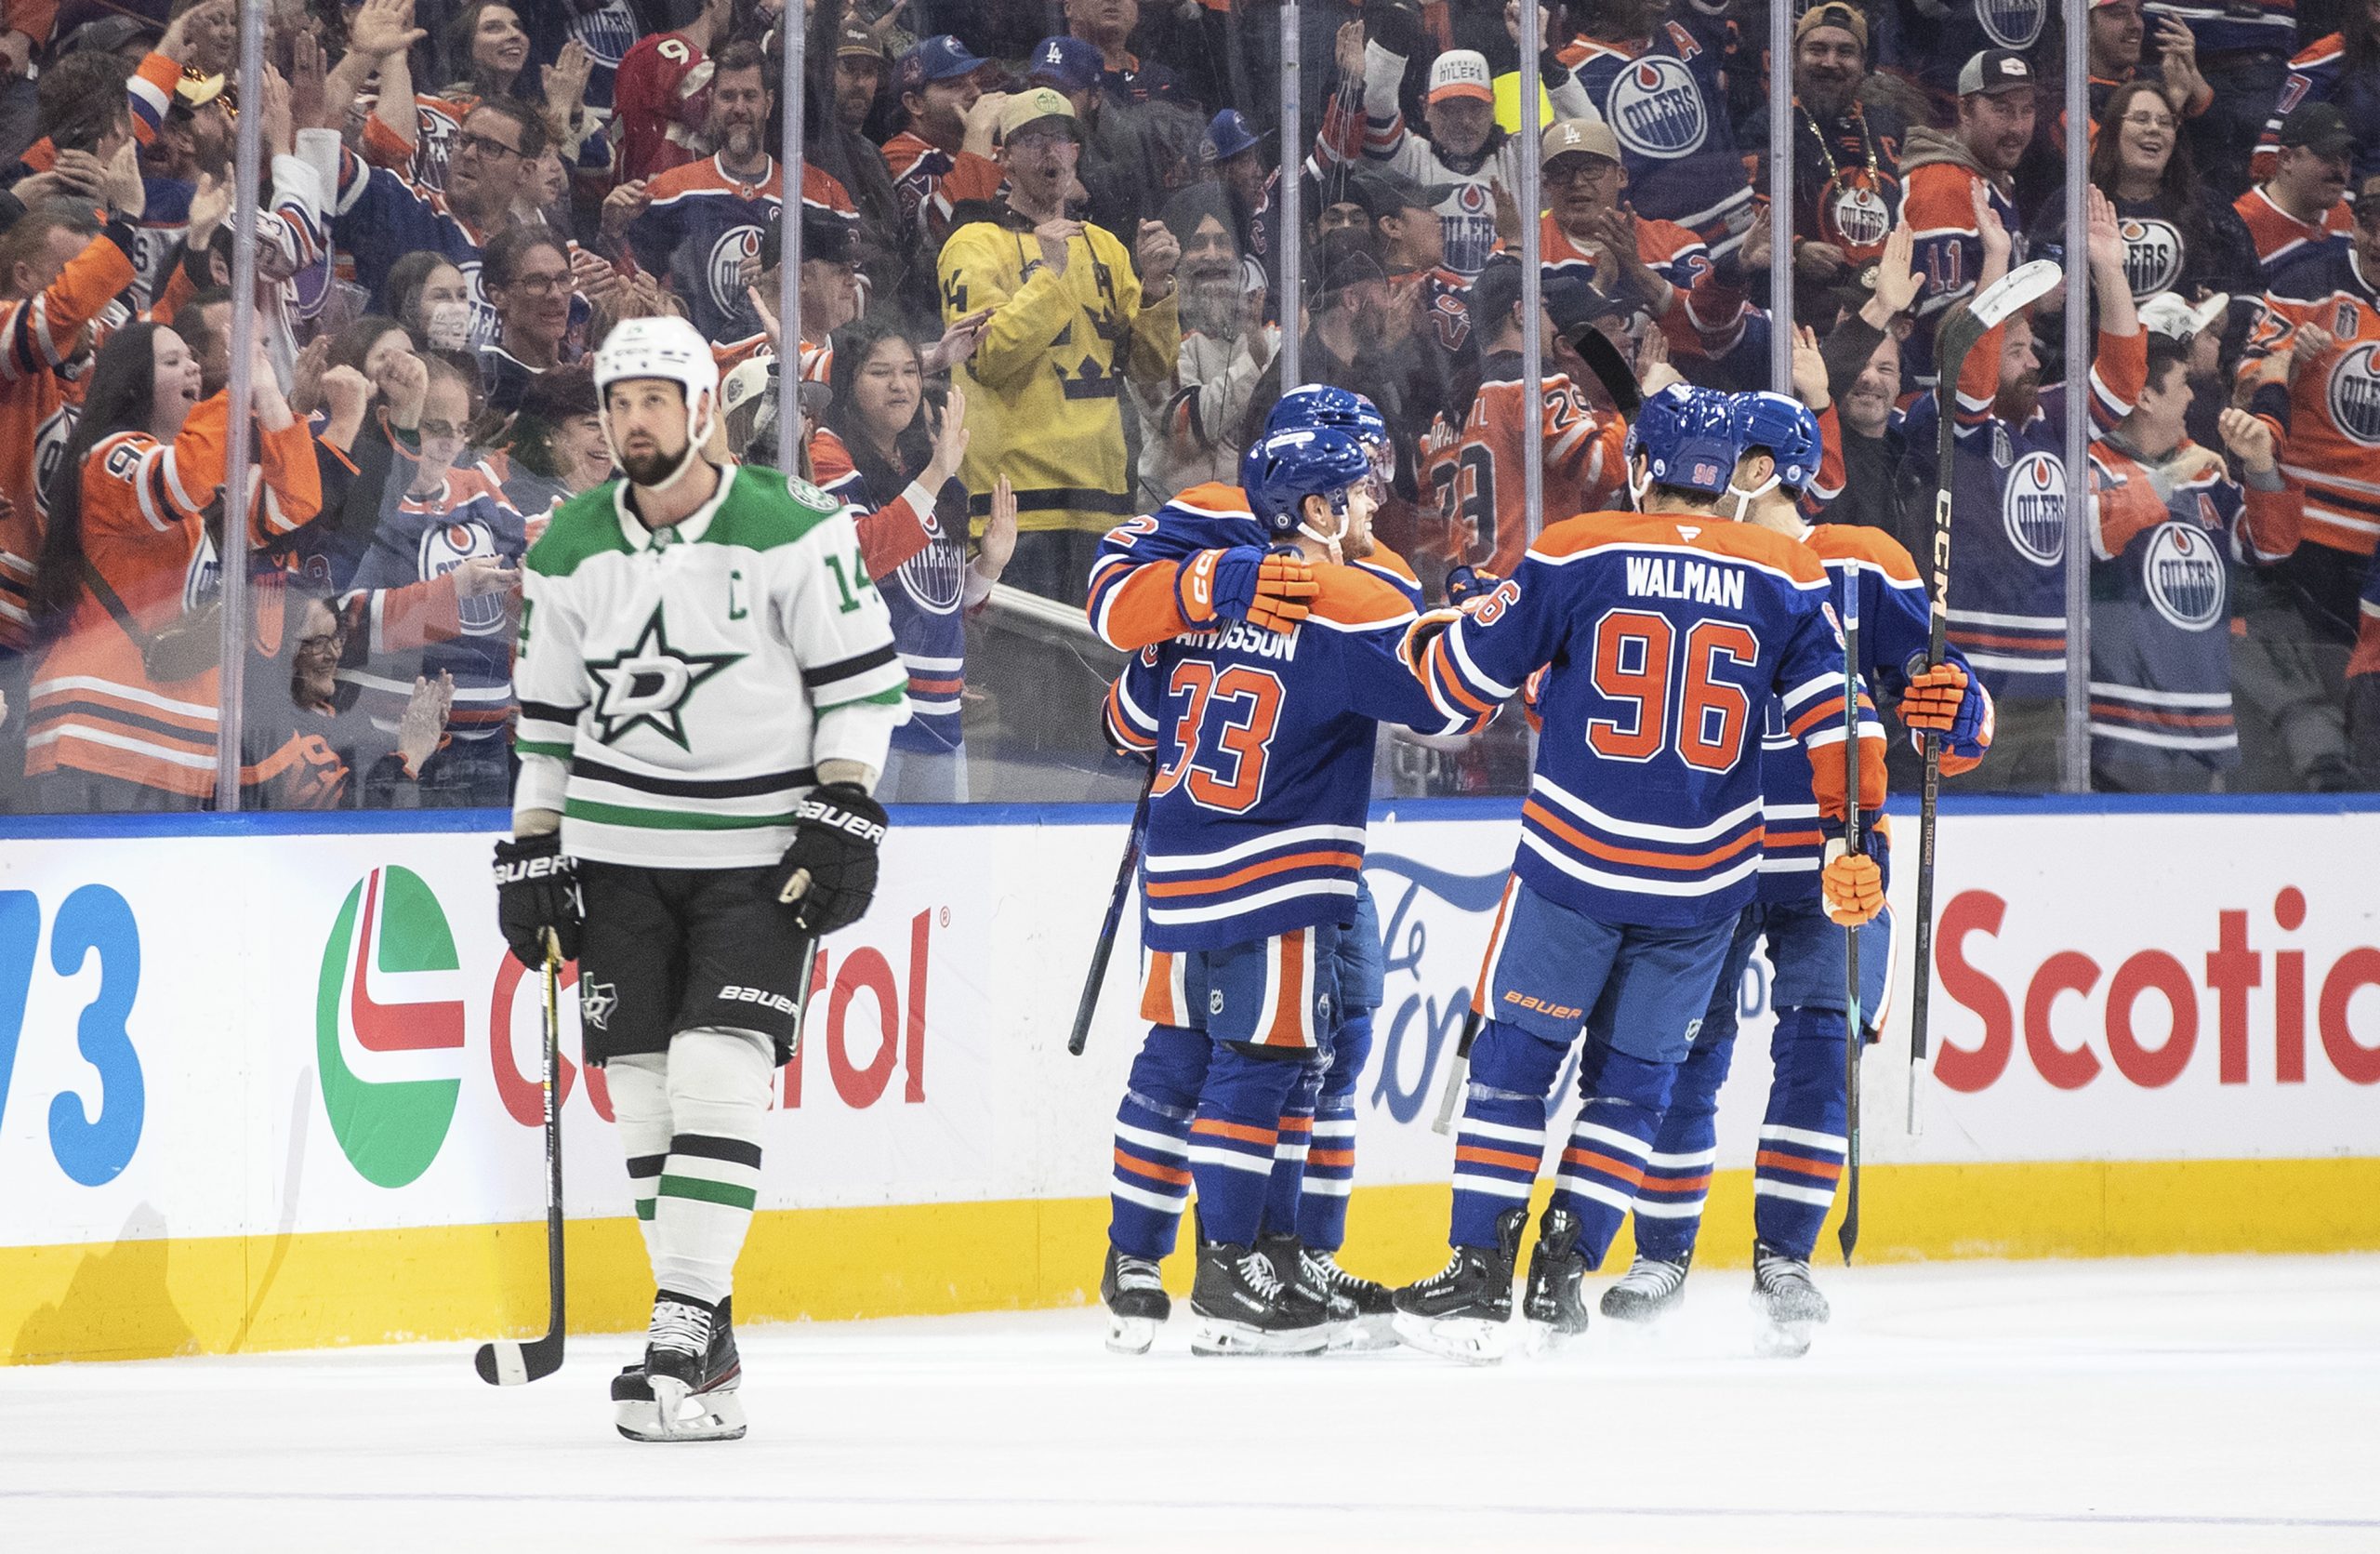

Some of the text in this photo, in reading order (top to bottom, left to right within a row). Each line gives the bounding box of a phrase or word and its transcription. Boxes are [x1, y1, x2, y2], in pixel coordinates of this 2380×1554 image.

[657, 39, 690, 65] 9
[1047, 42, 1063, 64] LA
[1665, 20, 1703, 62] A
[1623, 85, 1699, 131] OILERS
[1565, 124, 1581, 145] LA
[1841, 206, 1885, 230] OILERS
[1927, 239, 1963, 295] 11
[2123, 244, 2169, 269] ERS
[2342, 375, 2380, 405] OILE
[1692, 463, 1718, 485] 96
[2197, 493, 2224, 530] A
[1104, 514, 1159, 548] 2
[1932, 489, 1951, 618] CCM
[824, 547, 879, 614] 14
[1193, 550, 1221, 604] CC
[1627, 556, 1745, 610] WALMAN
[2159, 559, 2215, 588] OILERS
[729, 569, 748, 621] C
[1585, 607, 1760, 775] 96
[1851, 676, 1859, 715] NEXUS
[1148, 658, 1287, 815] 33
[1924, 823, 1935, 866] TRIGGER
[493, 854, 570, 885] AUER
[490, 907, 931, 1127] Crol
[718, 985, 800, 1017] BAUER
[1503, 990, 1583, 1019] BAUER
